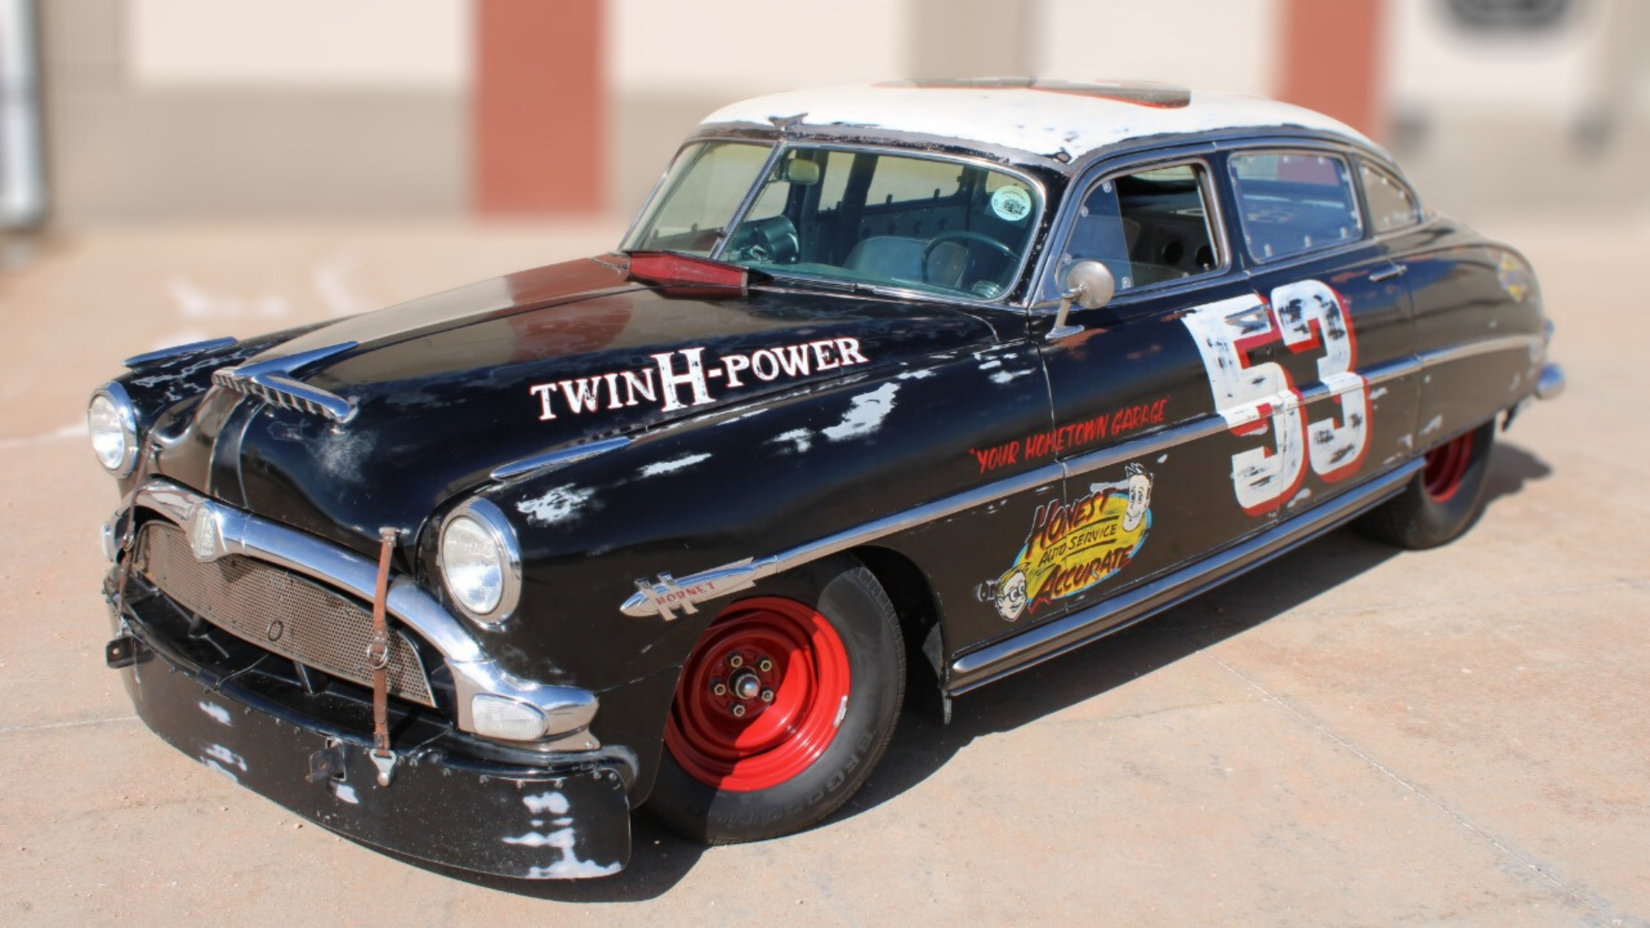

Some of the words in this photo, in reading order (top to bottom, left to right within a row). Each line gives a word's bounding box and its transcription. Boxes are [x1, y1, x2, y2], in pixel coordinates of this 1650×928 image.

[1180, 279, 1373, 516] 53
[1025, 414, 1109, 461] HOMETOWN
[1025, 487, 1117, 560] HONEST
[1038, 543, 1066, 567] AUTO
[1068, 524, 1117, 550] SERVICE
[655, 580, 715, 605] HORNET
[1028, 544, 1134, 613] ACCURATE
